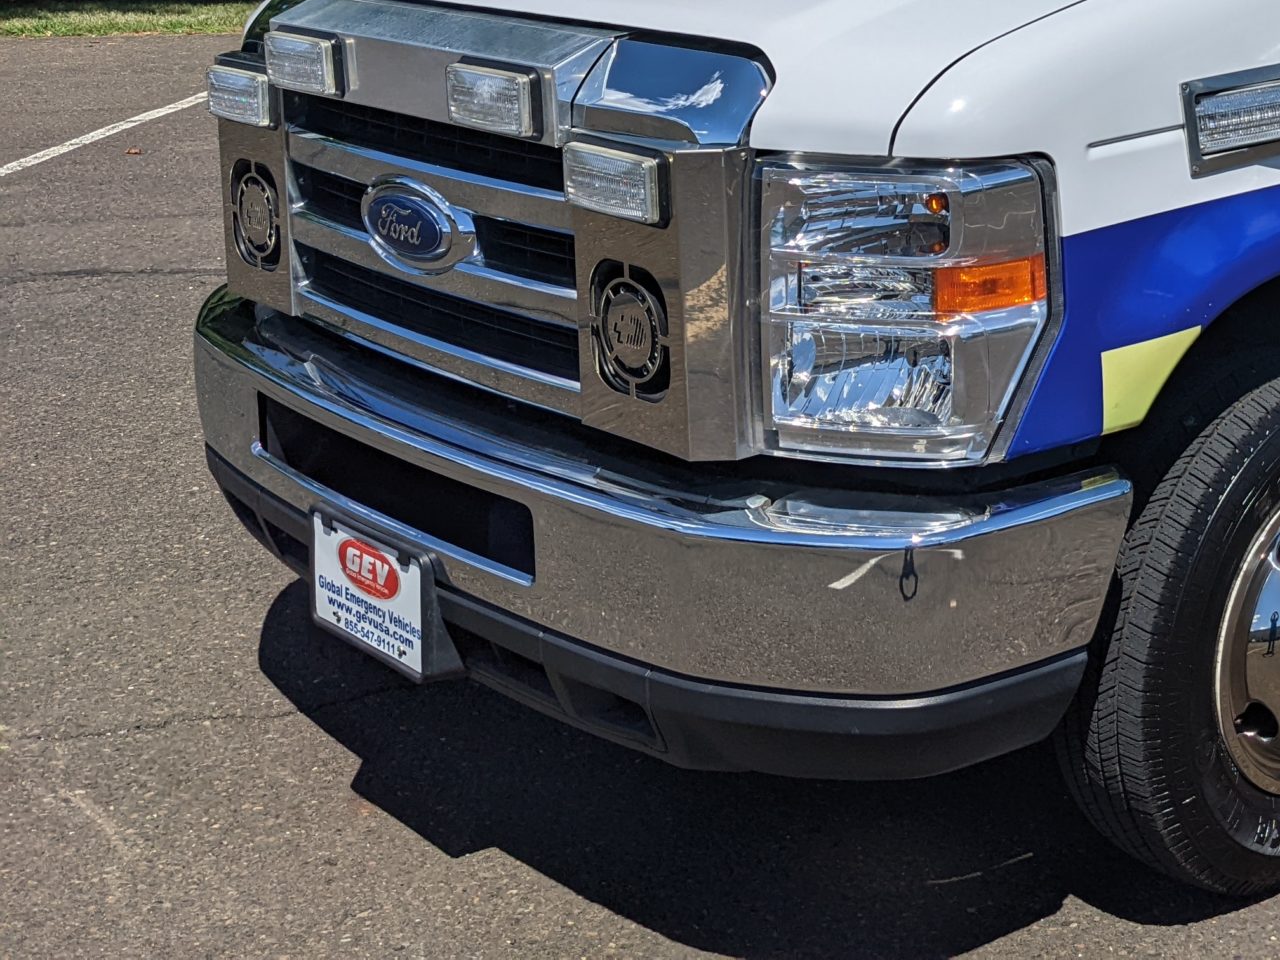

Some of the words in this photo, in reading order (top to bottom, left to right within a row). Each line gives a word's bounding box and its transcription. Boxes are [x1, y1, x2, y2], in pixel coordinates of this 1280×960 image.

[378, 202, 422, 245] Ford
[345, 547, 390, 586] GEV
[318, 574, 343, 597] Global
[344, 586, 386, 623] Emergency
[388, 608, 421, 641] Vehicles
[327, 595, 414, 650] www.gevusa.com
[344, 617, 395, 655] 855-547-9111
